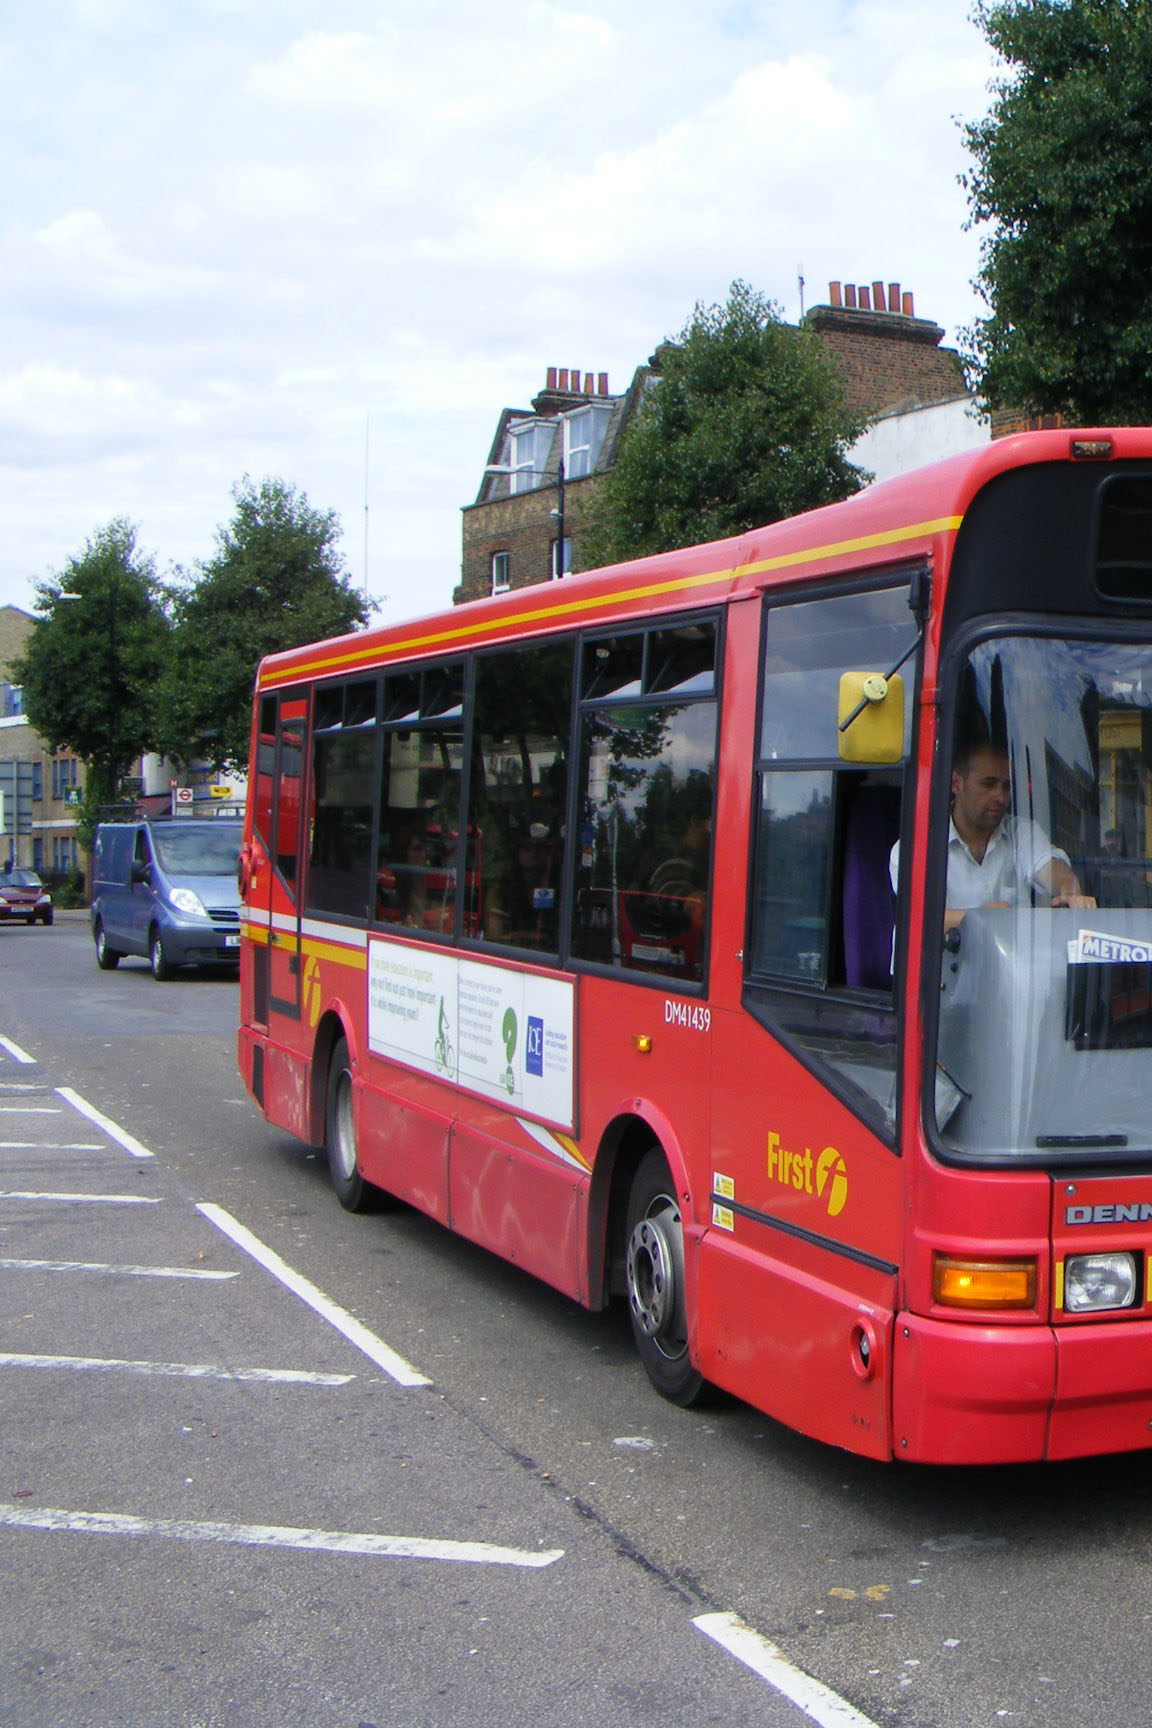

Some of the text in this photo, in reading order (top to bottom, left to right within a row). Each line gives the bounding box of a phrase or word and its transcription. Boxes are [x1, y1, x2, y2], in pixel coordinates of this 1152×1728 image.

[1083, 938, 1147, 963] METRO
[665, 1000, 711, 1031] DM41439
[768, 1131, 814, 1195] First
